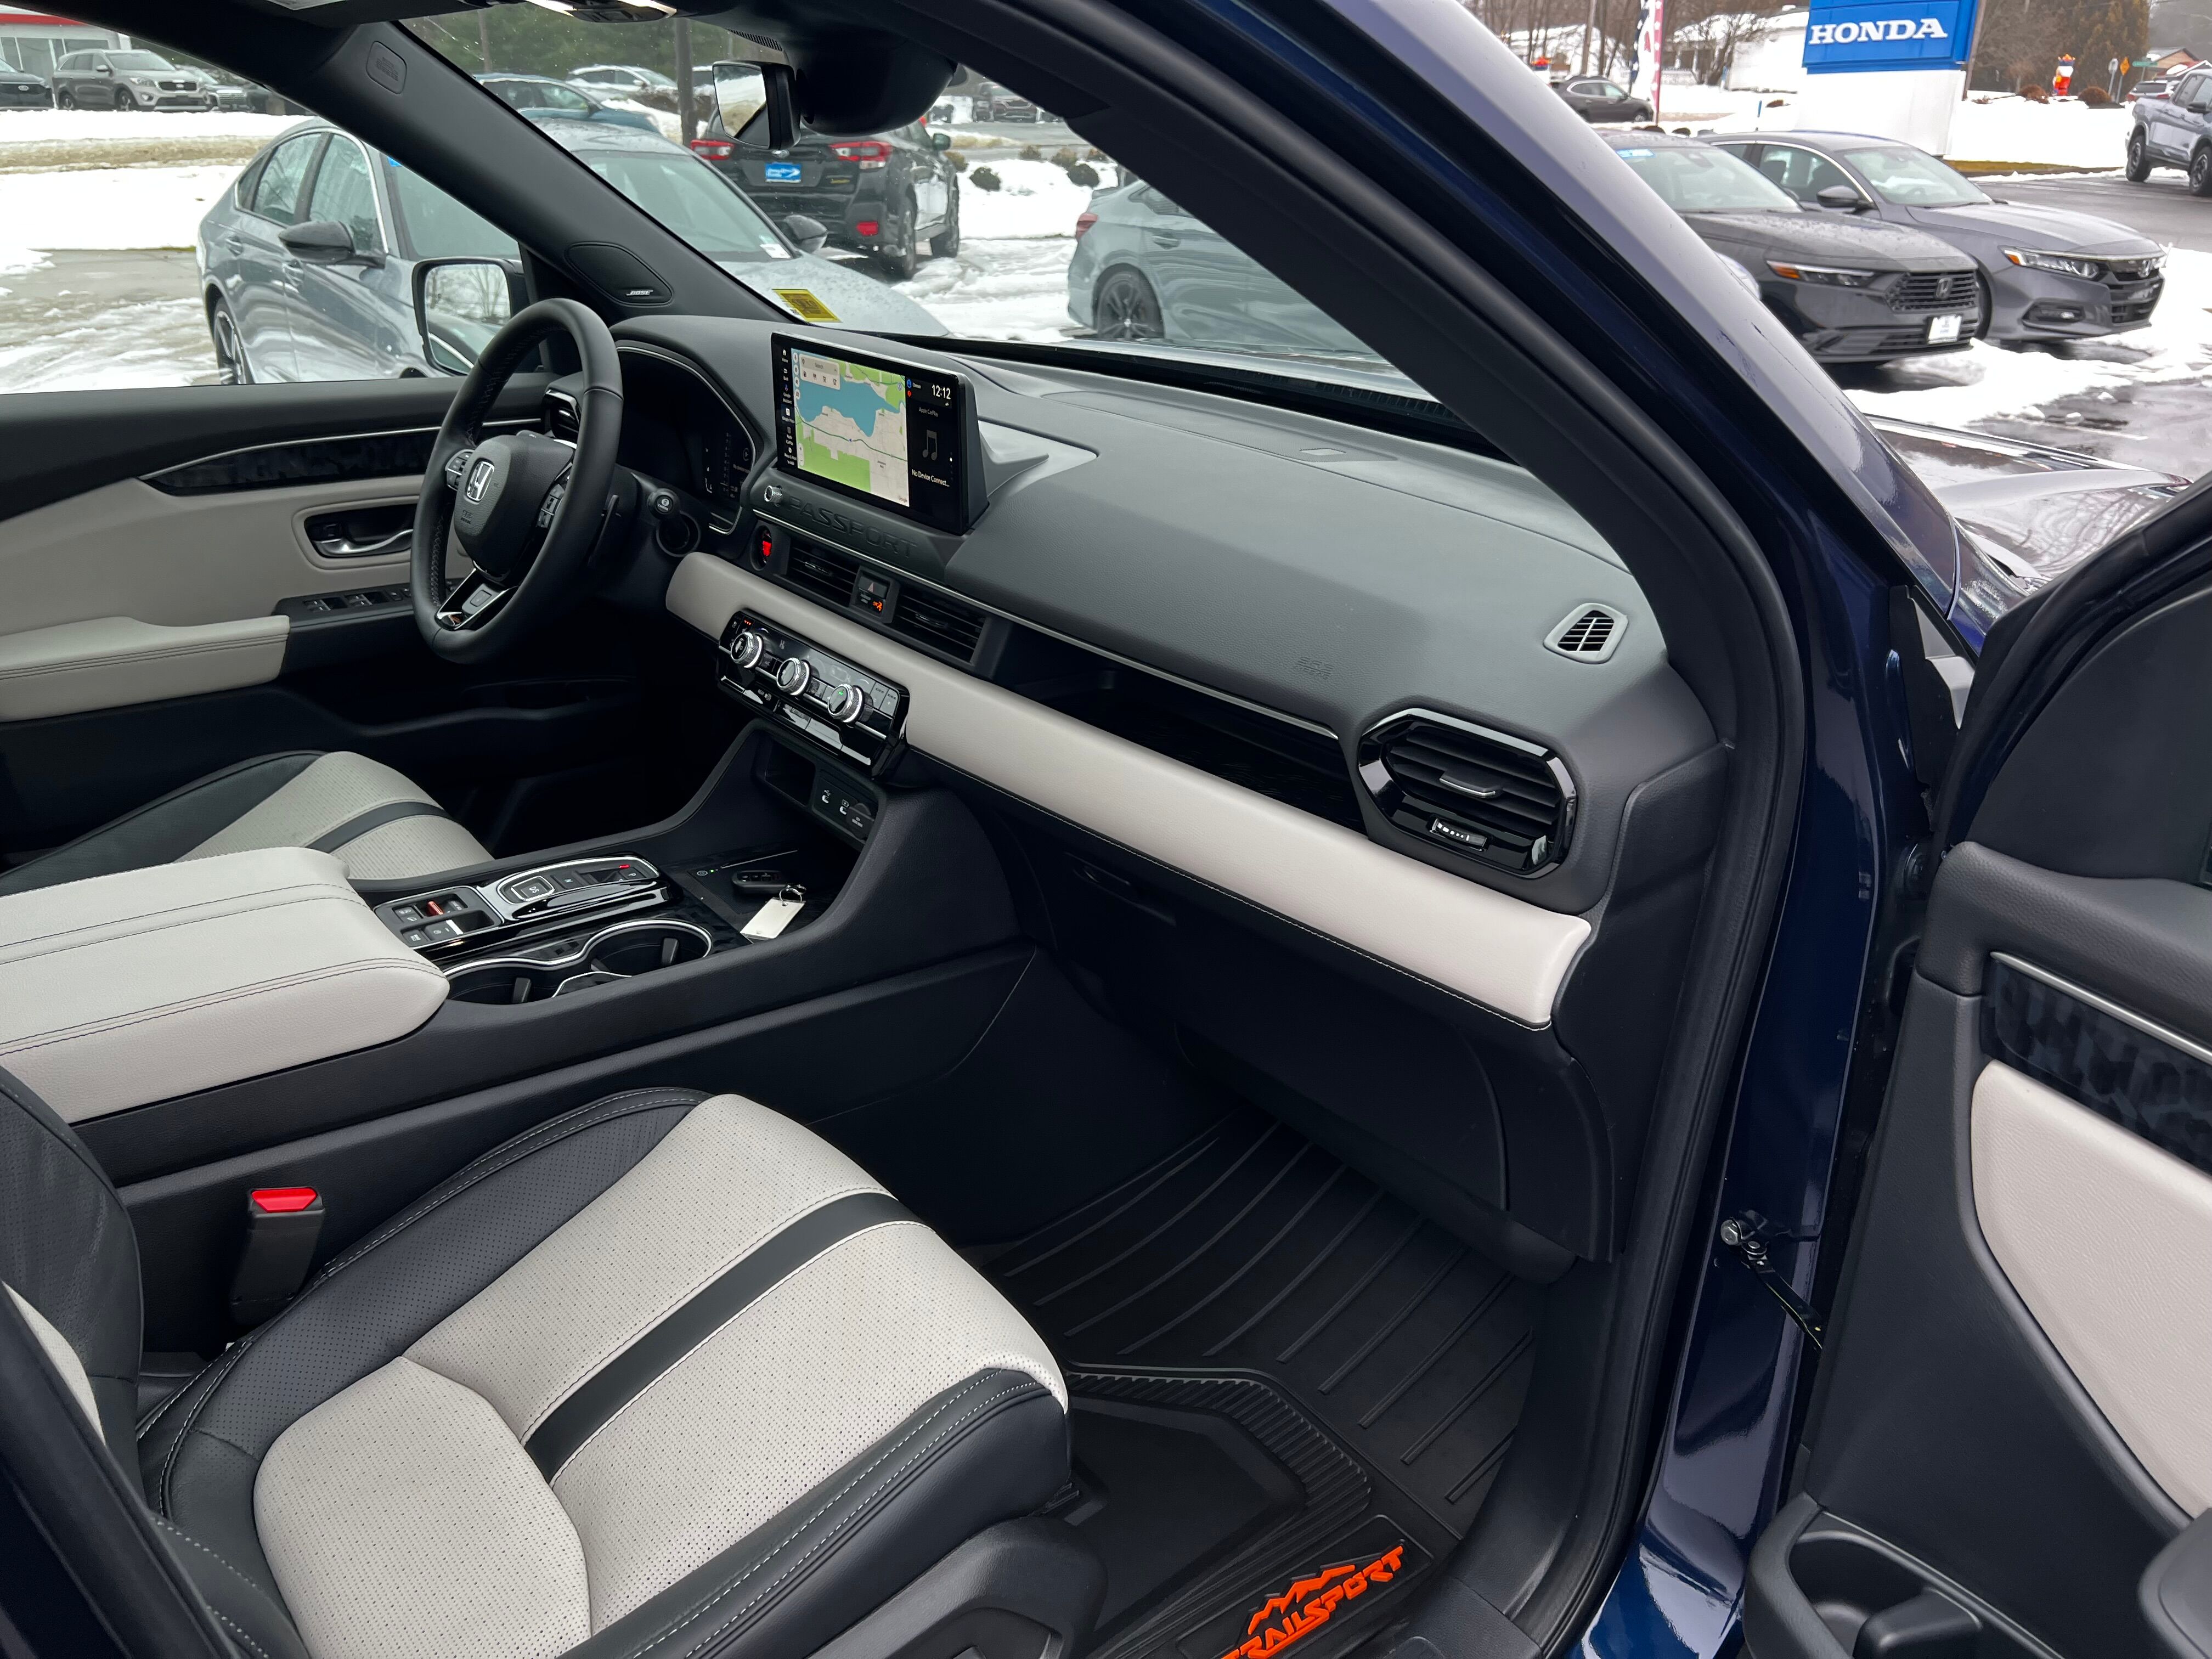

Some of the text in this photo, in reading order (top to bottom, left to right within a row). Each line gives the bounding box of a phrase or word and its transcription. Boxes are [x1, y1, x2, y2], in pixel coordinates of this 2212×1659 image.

[1809, 18, 1948, 45] HONDA
[932, 384, 951, 400] 12:12
[918, 471, 930, 481] Device
[789, 495, 918, 558] PASSPORT
